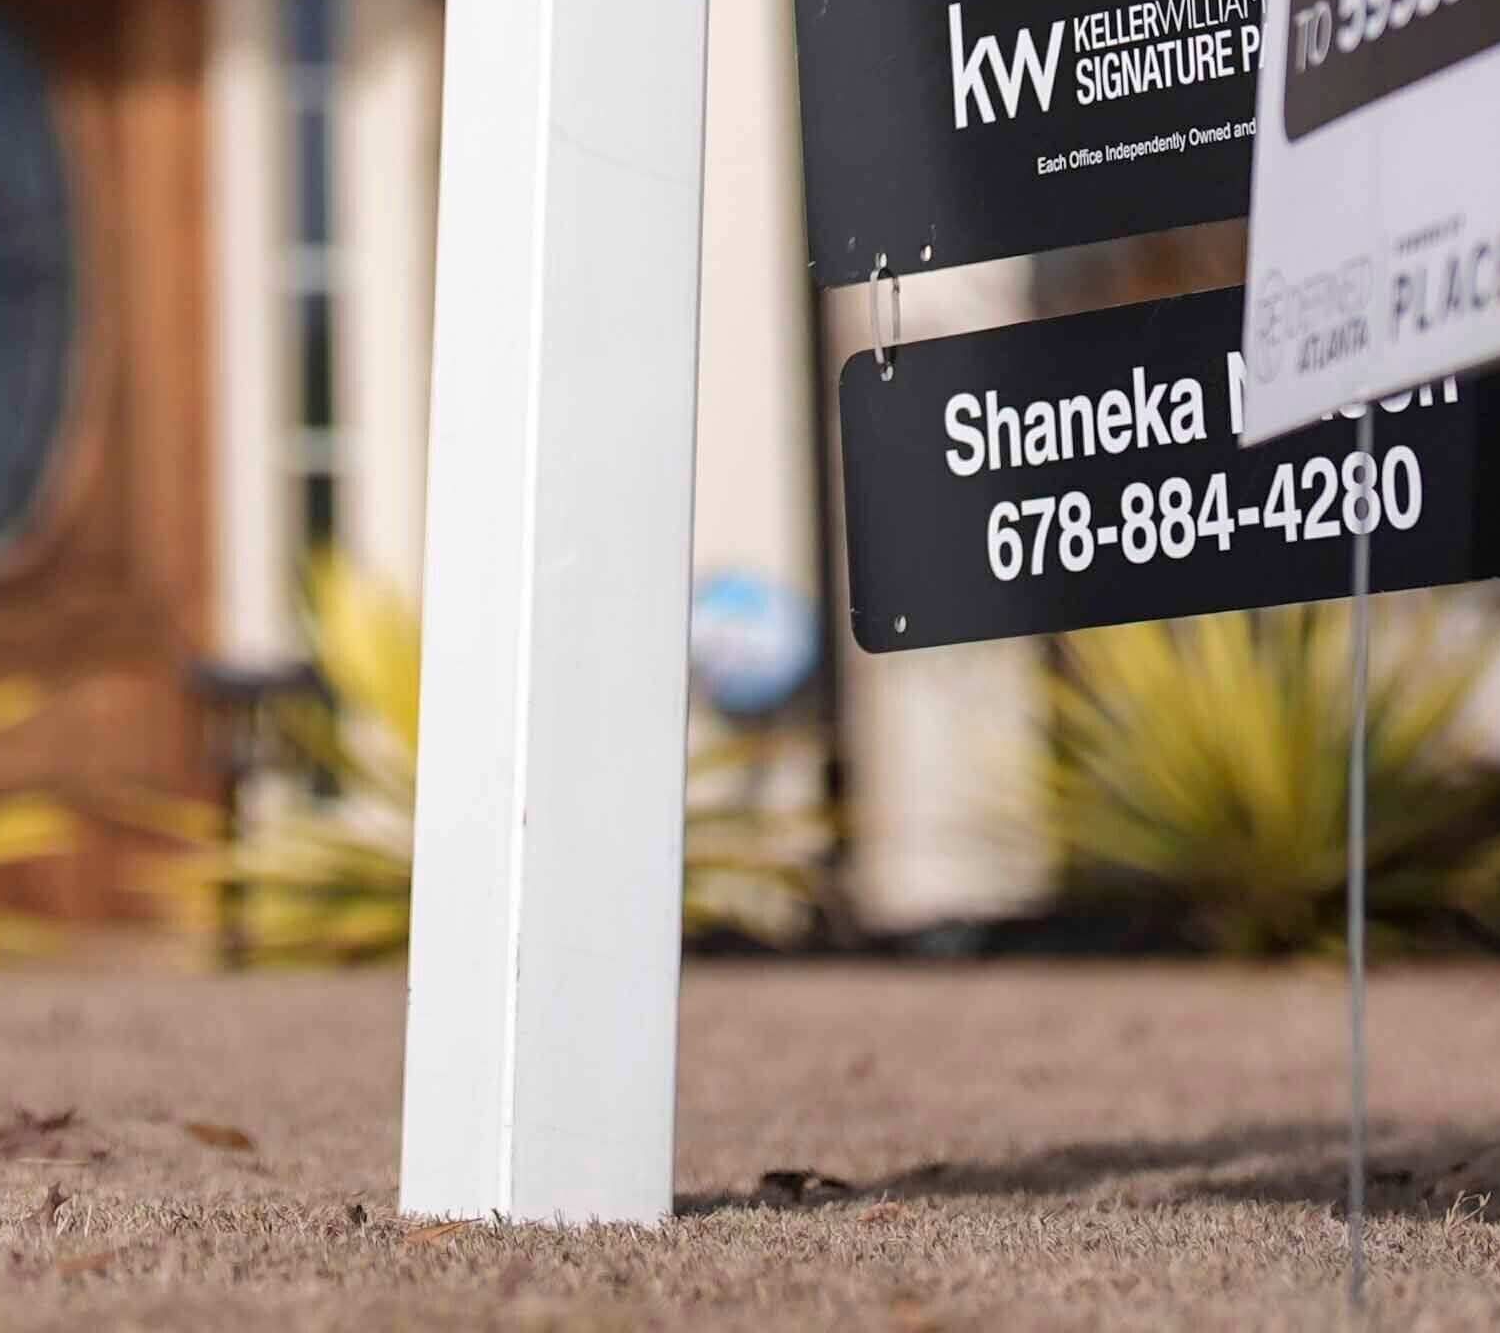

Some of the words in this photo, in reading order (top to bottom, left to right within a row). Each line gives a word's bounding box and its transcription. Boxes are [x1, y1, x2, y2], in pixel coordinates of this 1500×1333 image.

[948, 2, 1066, 130] kw
[1075, 29, 1235, 106] SIGNATURE
[1037, 154, 1067, 175] Each
[1068, 148, 1104, 169] Office
[1105, 131, 1187, 161] Independently
[1188, 121, 1232, 147] Owned
[1233, 117, 1258, 138] and
[943, 365, 1208, 478] Shaneka
[985, 443, 1423, 583] 678-884-4280
